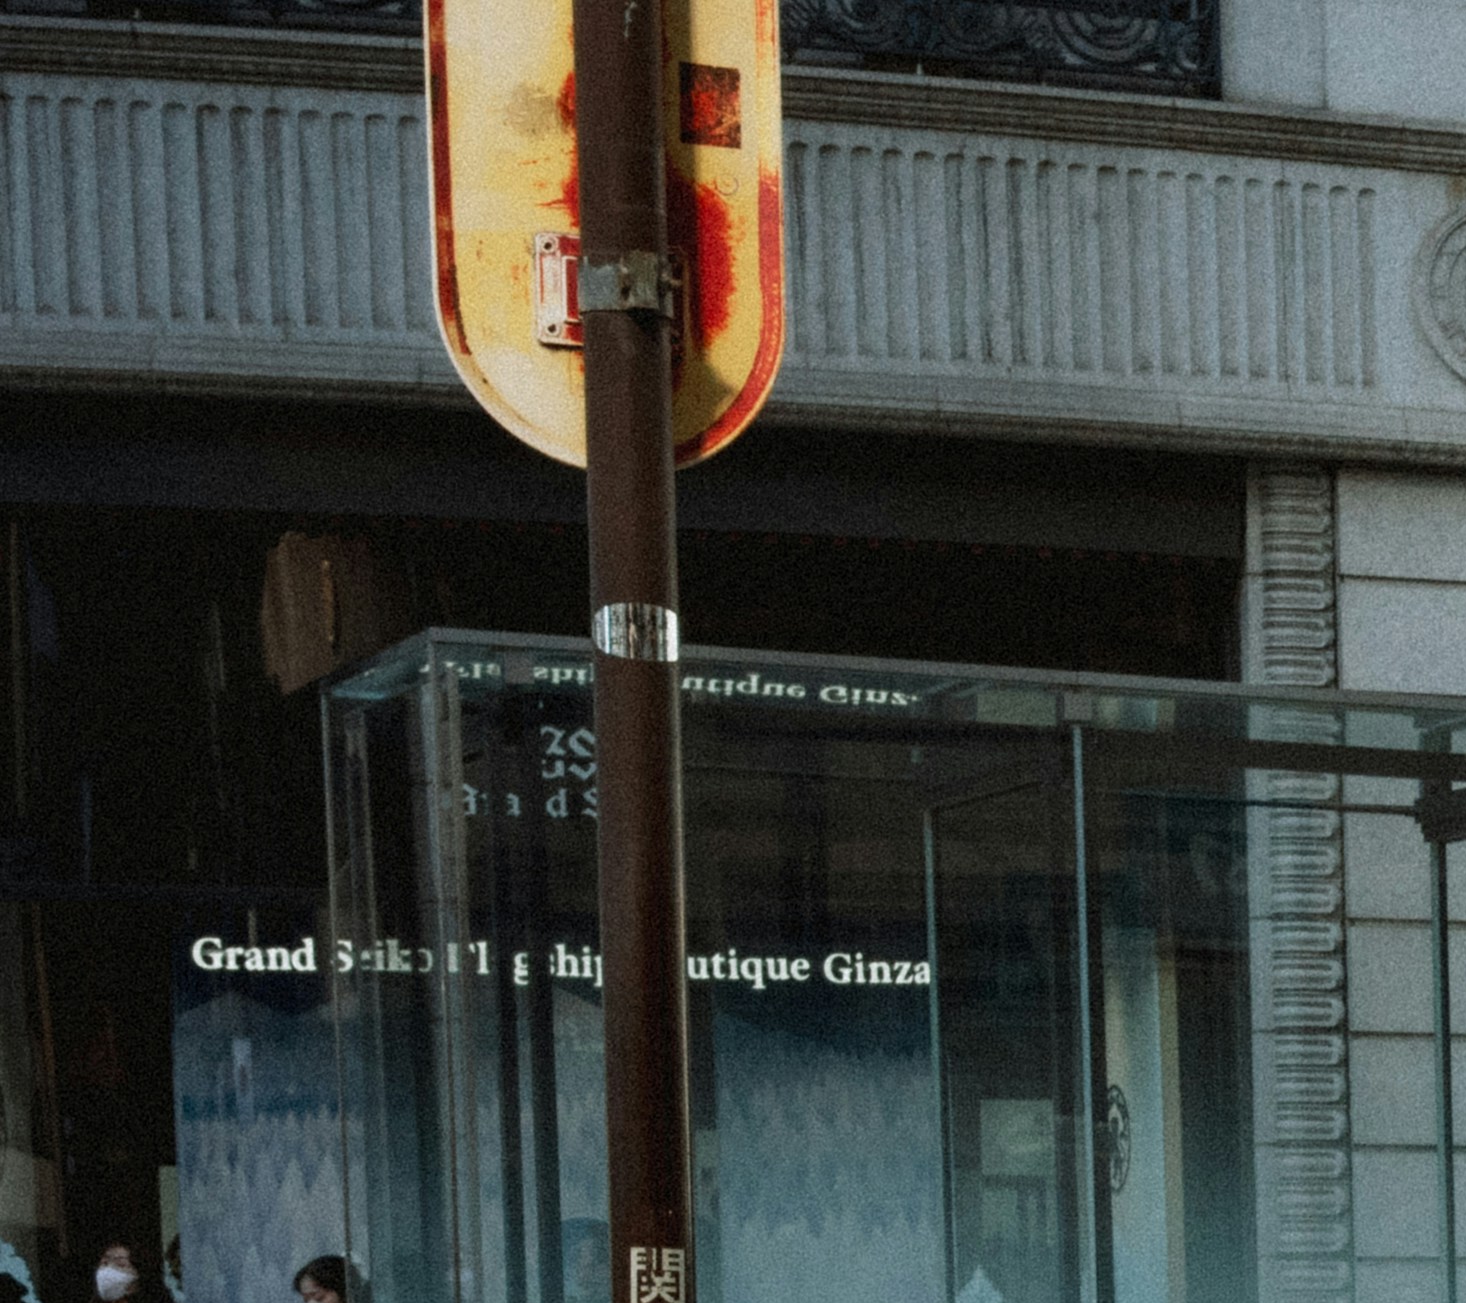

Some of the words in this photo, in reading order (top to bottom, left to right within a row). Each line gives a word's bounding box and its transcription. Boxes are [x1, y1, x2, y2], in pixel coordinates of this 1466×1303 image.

[192, 936, 316, 972] Grand
[686, 949, 810, 989] utique
[823, 953, 932, 985] Ginza
